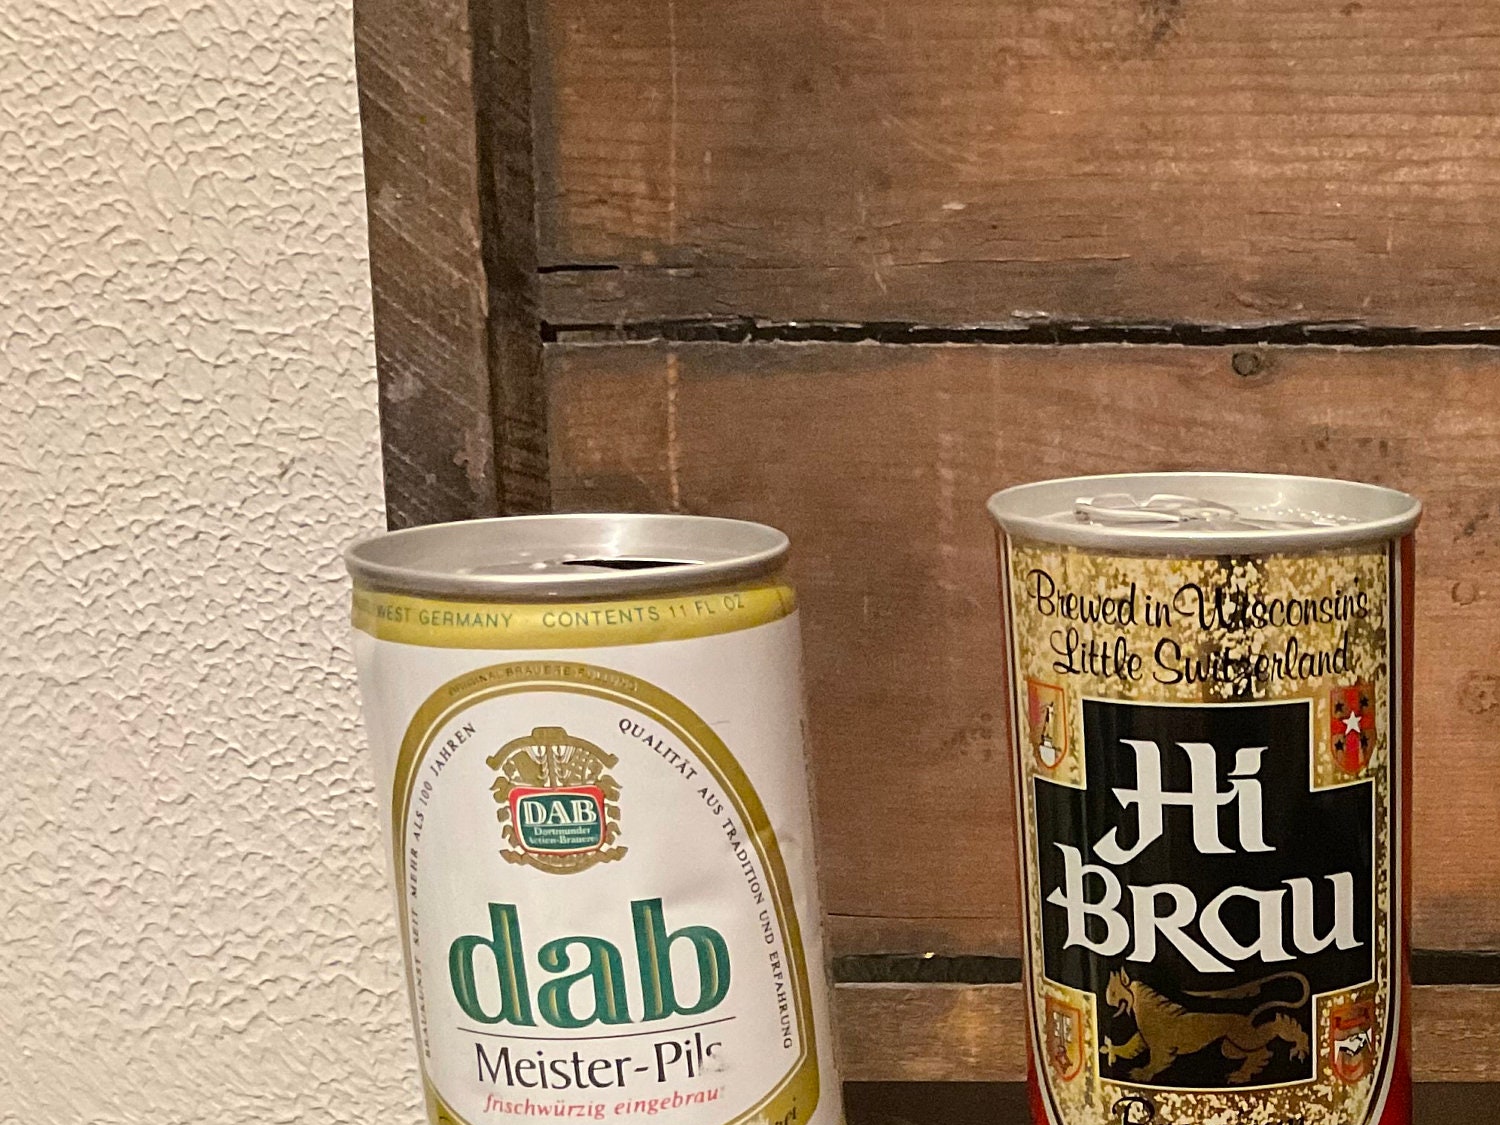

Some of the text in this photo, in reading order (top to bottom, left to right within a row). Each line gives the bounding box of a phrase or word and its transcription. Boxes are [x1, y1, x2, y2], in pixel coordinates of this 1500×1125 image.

[377, 594, 745, 628] WEST GERMANY CONTENTS 11 FL OZ
[1026, 569, 1139, 626] Brewed
[1144, 595, 1172, 628] in
[1050, 627, 1350, 686] Little Switzerland
[410, 848, 418, 898] MEHR
[414, 810, 425, 842] ALS
[430, 722, 477, 776] JAHREN
[522, 799, 598, 825] DAB
[1092, 738, 1277, 866] Hi
[618, 718, 793, 1049] QUALITÄT AUS TRADITION UND ERFAHRUNG
[449, 897, 732, 1029] dab
[613, 1085, 726, 1117] eingebrau
